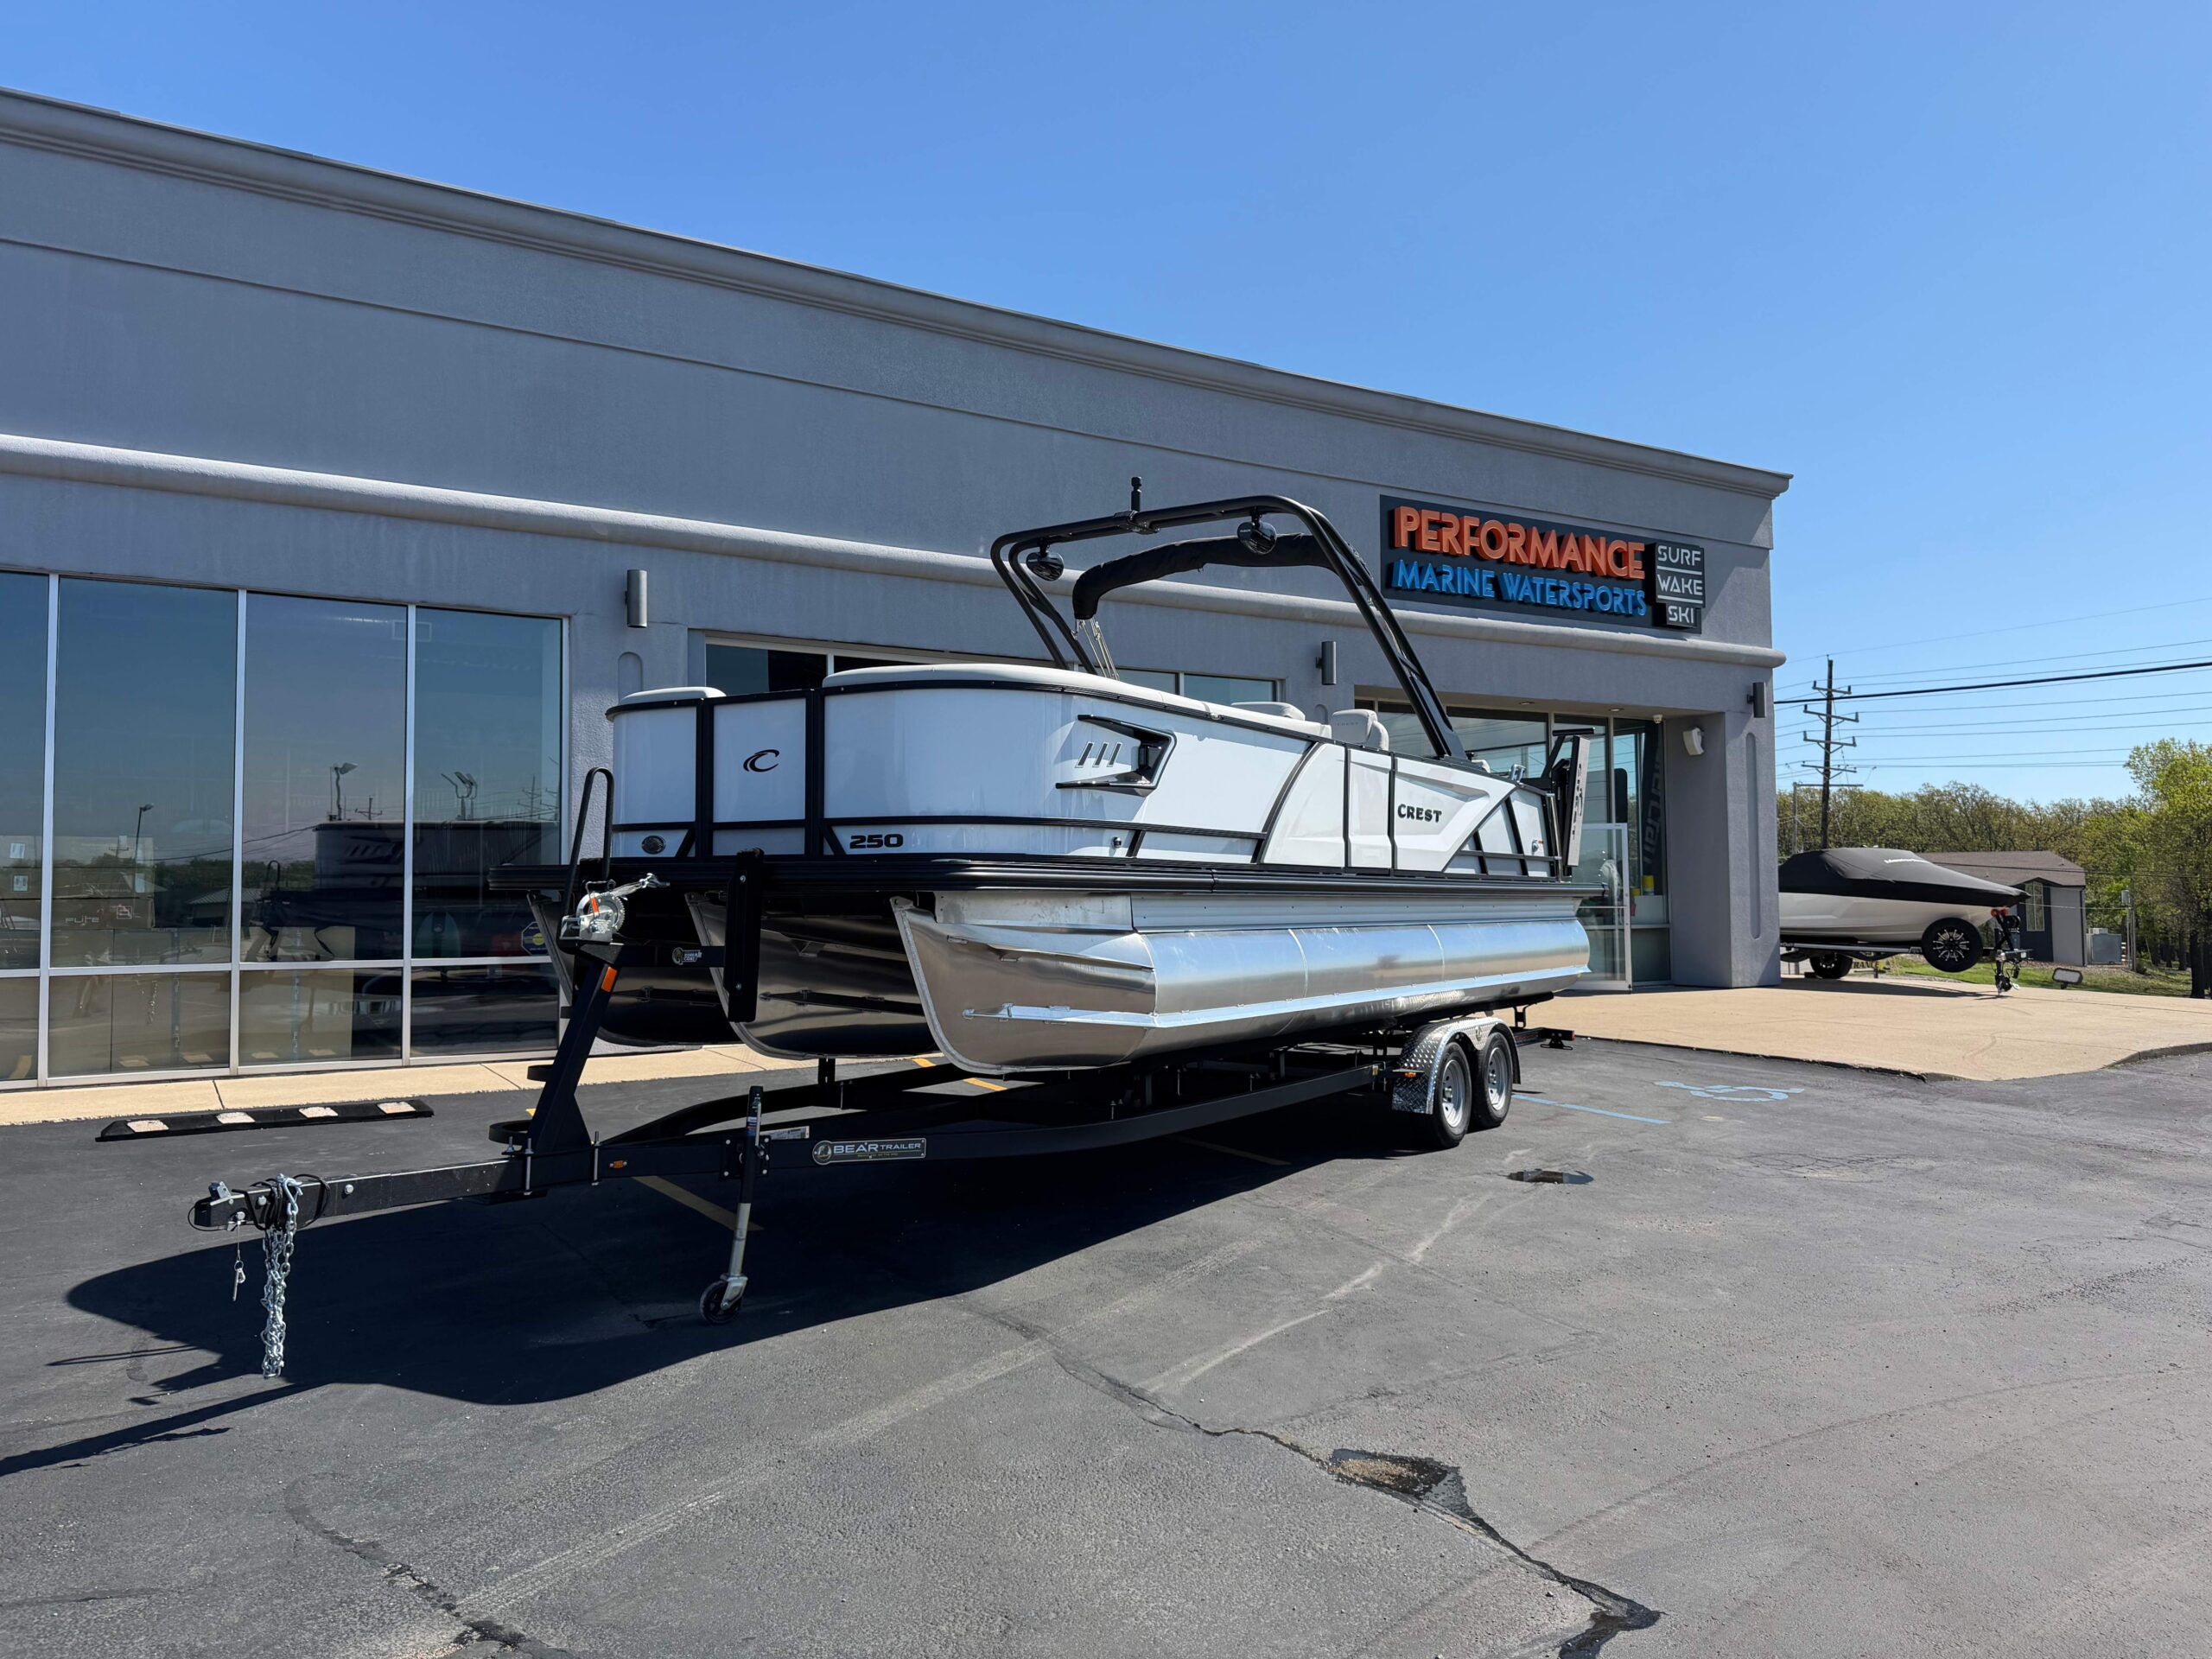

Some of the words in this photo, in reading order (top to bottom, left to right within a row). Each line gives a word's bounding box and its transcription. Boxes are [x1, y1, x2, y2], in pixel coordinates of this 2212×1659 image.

[1395, 506, 1645, 580] PERFORMANCE
[1657, 544, 1702, 566] SURF
[1393, 560, 1494, 598] MARINE
[1497, 571, 1646, 616] WATERSPORTS
[1657, 574, 1704, 597] WAKE
[1668, 605, 1695, 624] SKI
[1397, 803, 1443, 823] CREST
[849, 833, 904, 849] 250
[833, 1143, 879, 1154] BEAR
